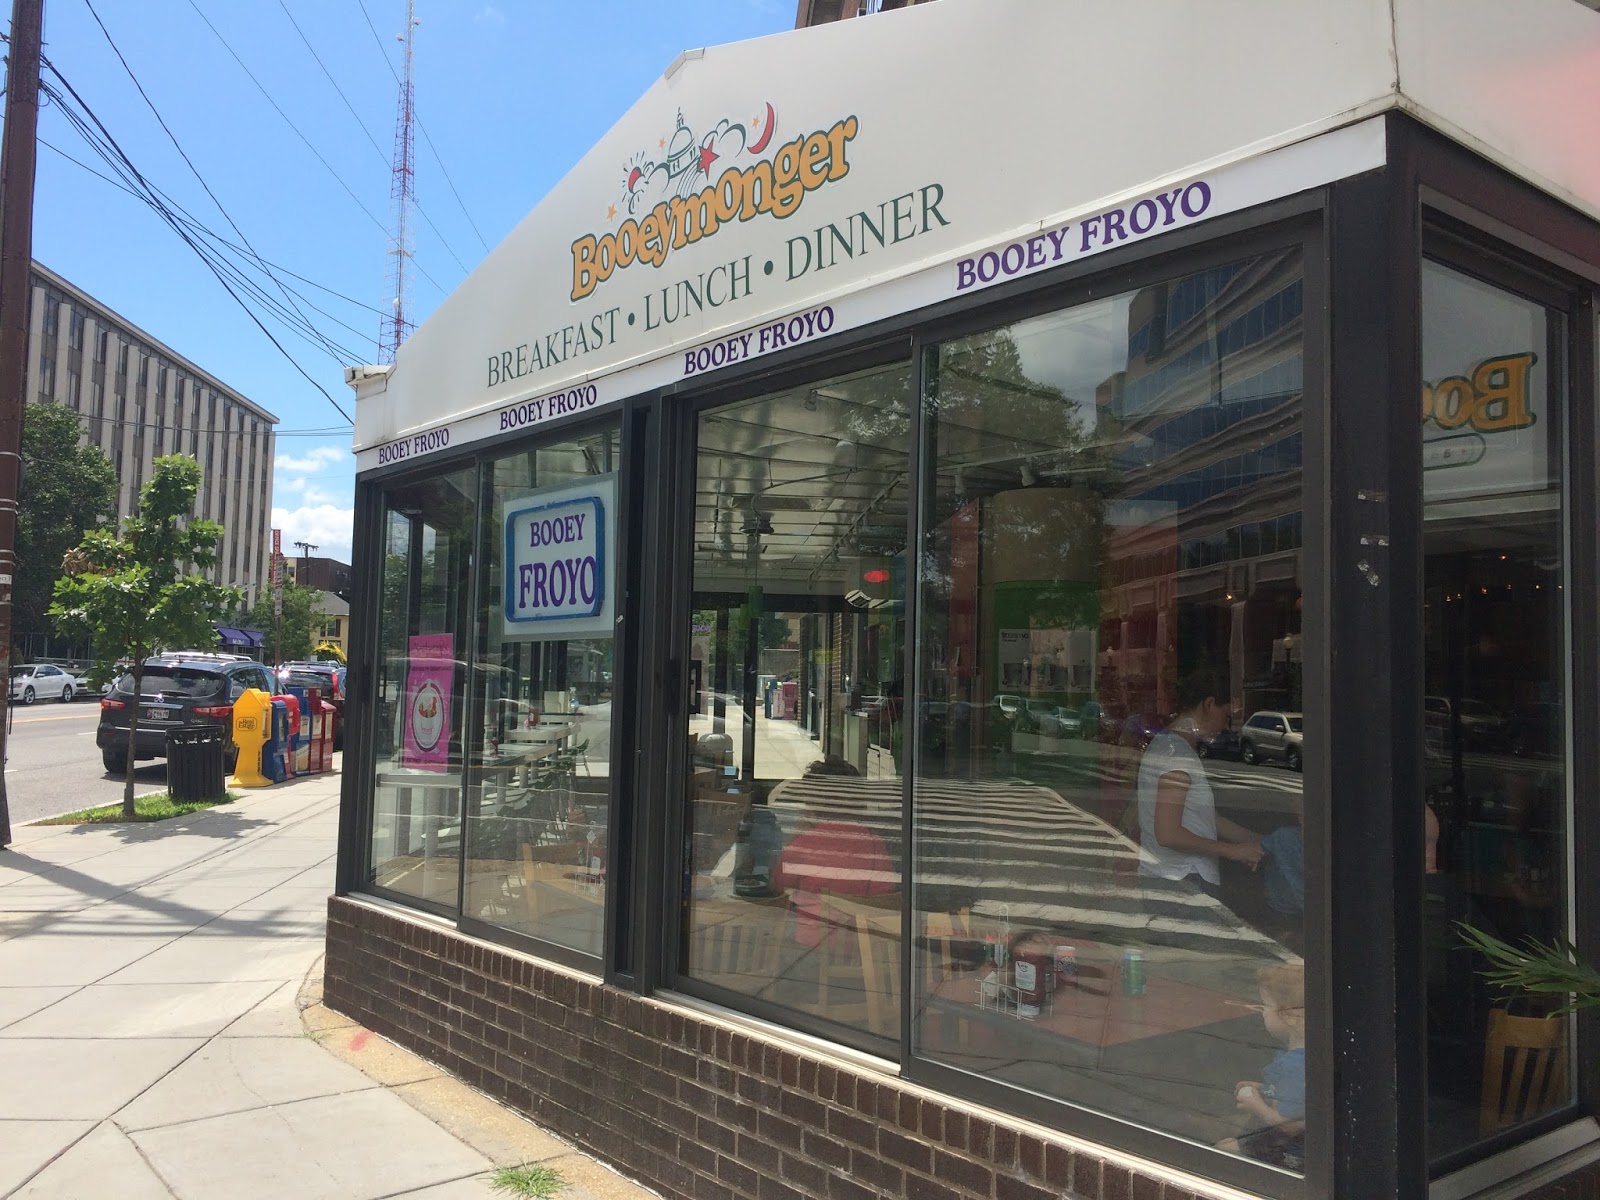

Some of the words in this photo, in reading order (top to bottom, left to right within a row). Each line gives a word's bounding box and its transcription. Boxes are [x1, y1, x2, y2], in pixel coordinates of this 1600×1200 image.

[569, 114, 858, 302] Booeymonger
[956, 226, 1069, 290] BOOEY
[1079, 181, 1211, 252] FROYO
[487, 307, 620, 388] BREAKFAST
[644, 255, 753, 332] LUNCH
[785, 183, 951, 282] DINNER
[684, 333, 753, 375] BOOEY
[758, 306, 834, 353] FROYO
[500, 400, 545, 430] BOOEY
[548, 384, 597, 416] FROYO
[379, 438, 412, 464] BOOEY
[414, 428, 450, 454] FROYO
[530, 513, 585, 547] BOOEY
[519, 555, 597, 608] FROYO
